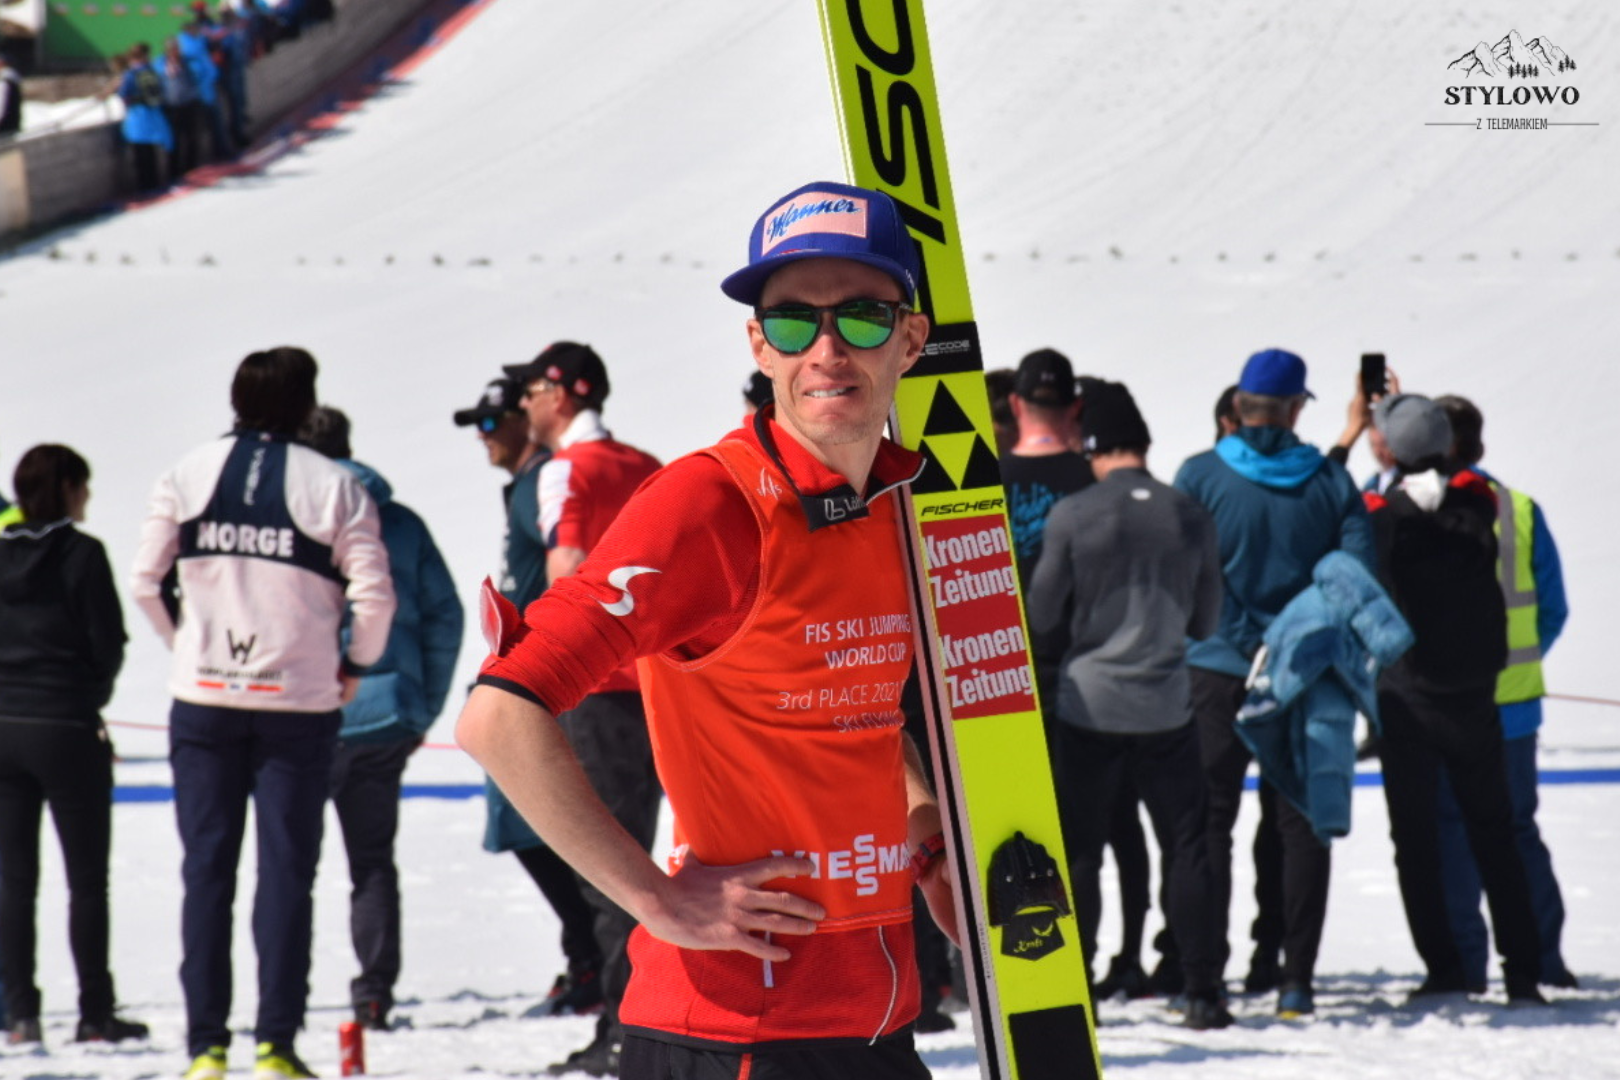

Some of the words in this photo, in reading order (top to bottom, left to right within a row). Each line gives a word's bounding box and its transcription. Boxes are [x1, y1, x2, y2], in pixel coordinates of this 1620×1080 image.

[767, 199, 862, 243] Manner
[921, 498, 1003, 516] FISCHER
[197, 521, 294, 557] NORGE
[922, 526, 1009, 570] Kronen
[928, 565, 1018, 609] Zeitung
[805, 622, 831, 645] FIS
[836, 617, 864, 641] SKI
[869, 613, 911, 636] JUMPING
[938, 625, 1026, 670] Kronen
[825, 646, 886, 670] WORLD
[888, 642, 907, 662] CUP
[776, 689, 813, 711] 3rd
[819, 684, 868, 708] PLACE
[944, 664, 1034, 708] Zeitung
